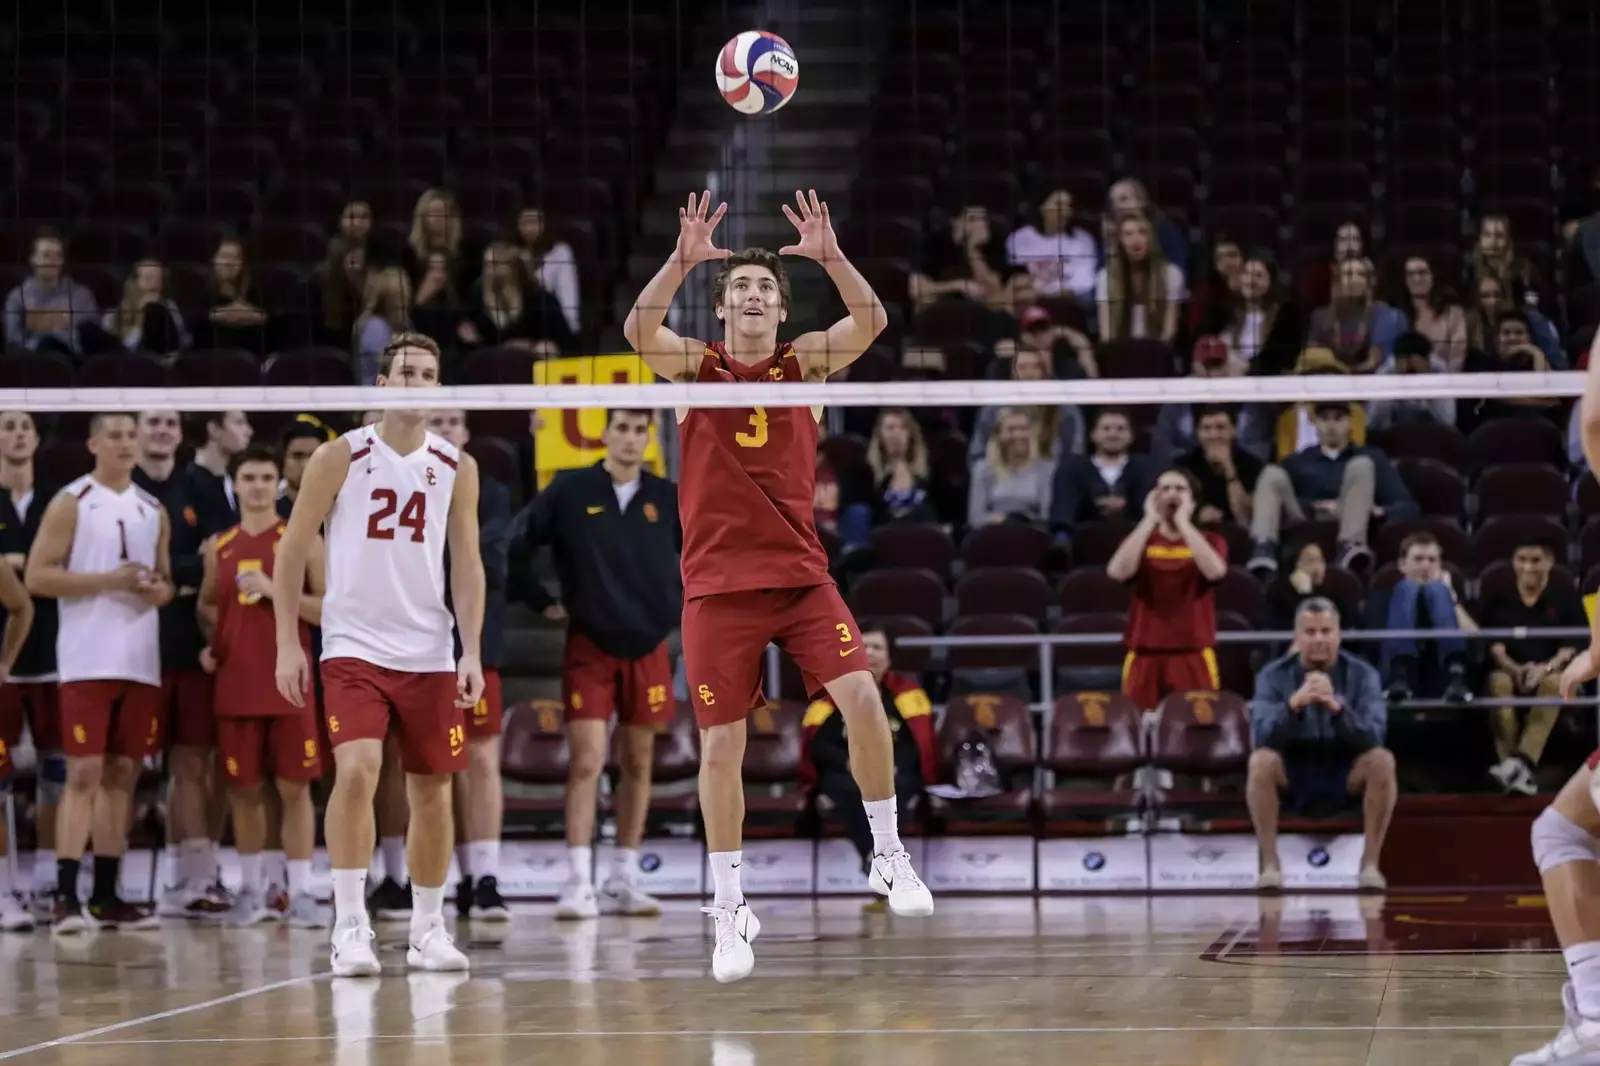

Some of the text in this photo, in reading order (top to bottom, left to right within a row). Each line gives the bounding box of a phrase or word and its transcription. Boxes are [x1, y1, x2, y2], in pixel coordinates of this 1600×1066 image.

[770, 54, 794, 75] NCAA
[735, 404, 768, 448] 3
[367, 488, 427, 543] 24
[117, 519, 128, 559] 1
[836, 623, 852, 643] 3
[698, 684, 715, 706] SC
[449, 724, 465, 747] 24
